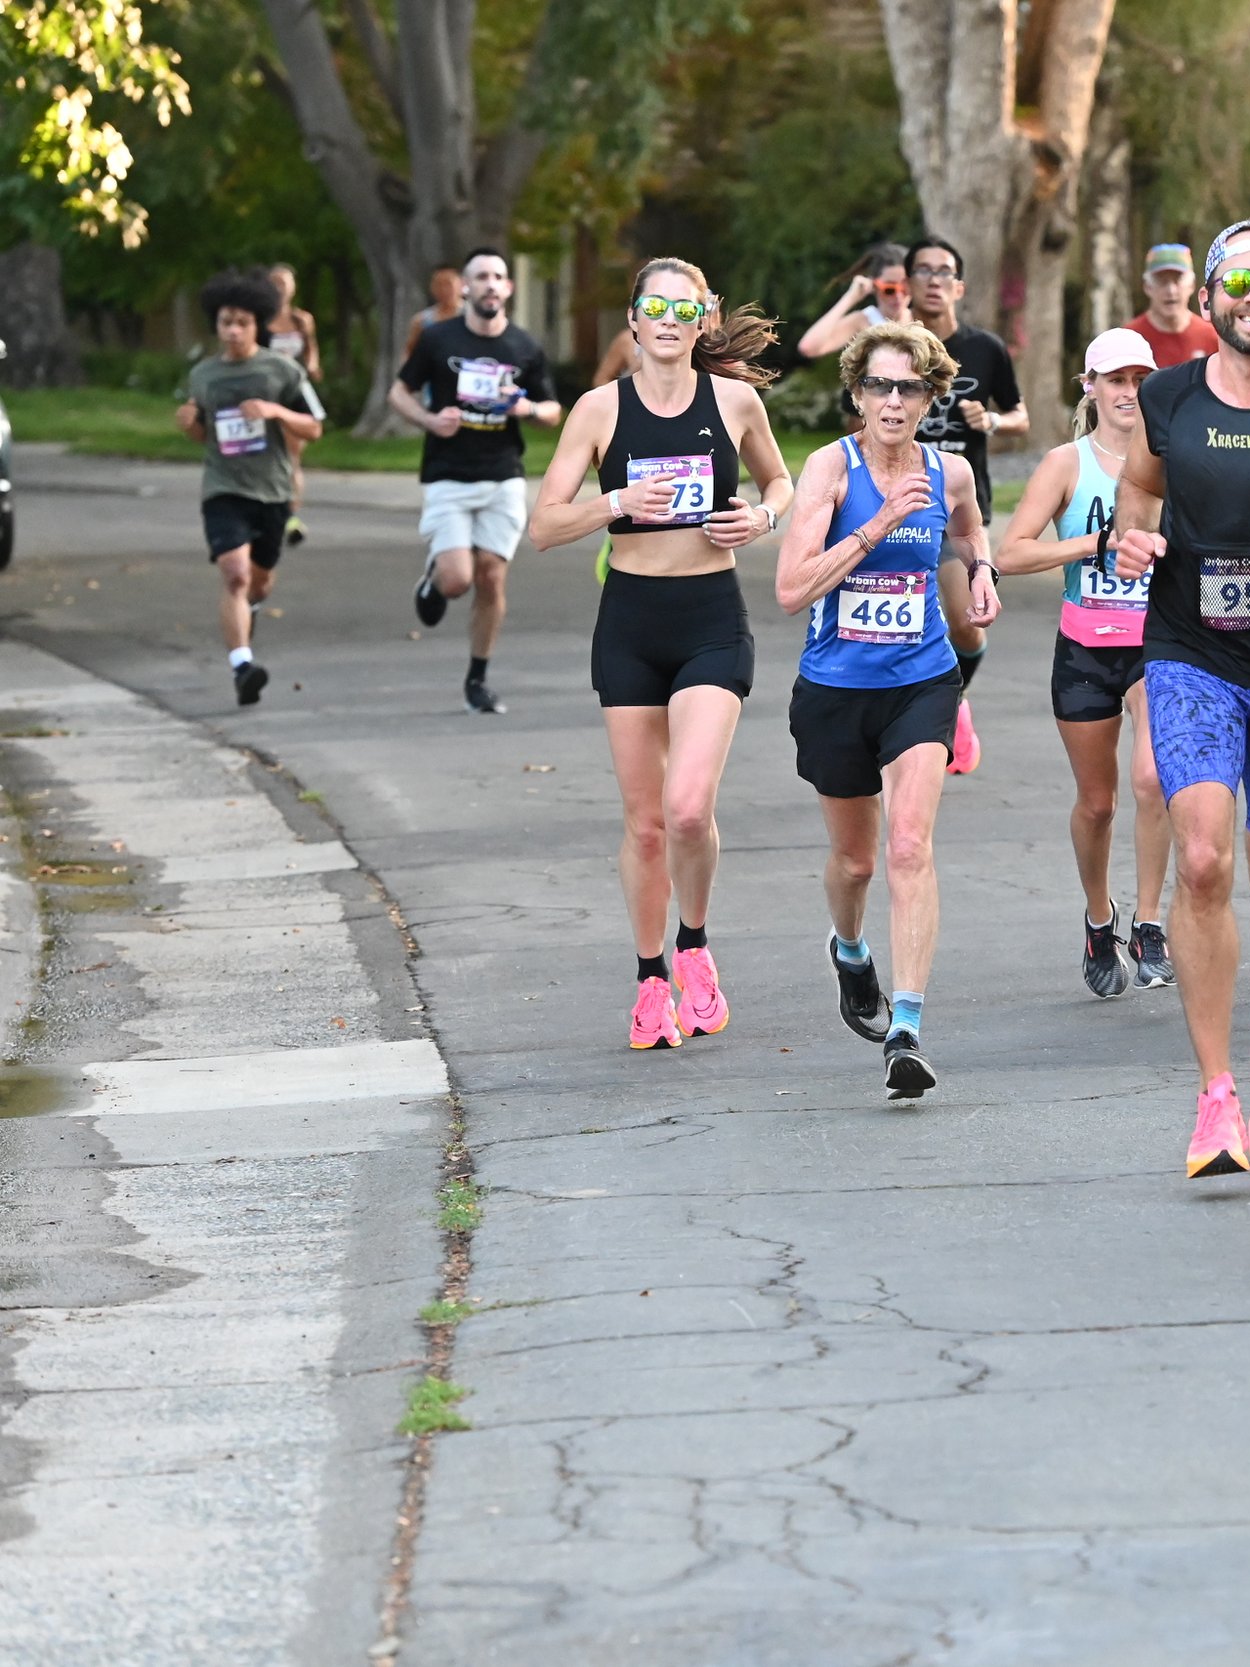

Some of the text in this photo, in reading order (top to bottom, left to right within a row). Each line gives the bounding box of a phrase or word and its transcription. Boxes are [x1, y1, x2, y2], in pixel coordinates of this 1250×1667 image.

[845, 575, 876, 585] Urban
[877, 578, 899, 586] Cow
[851, 600, 912, 627] 466
